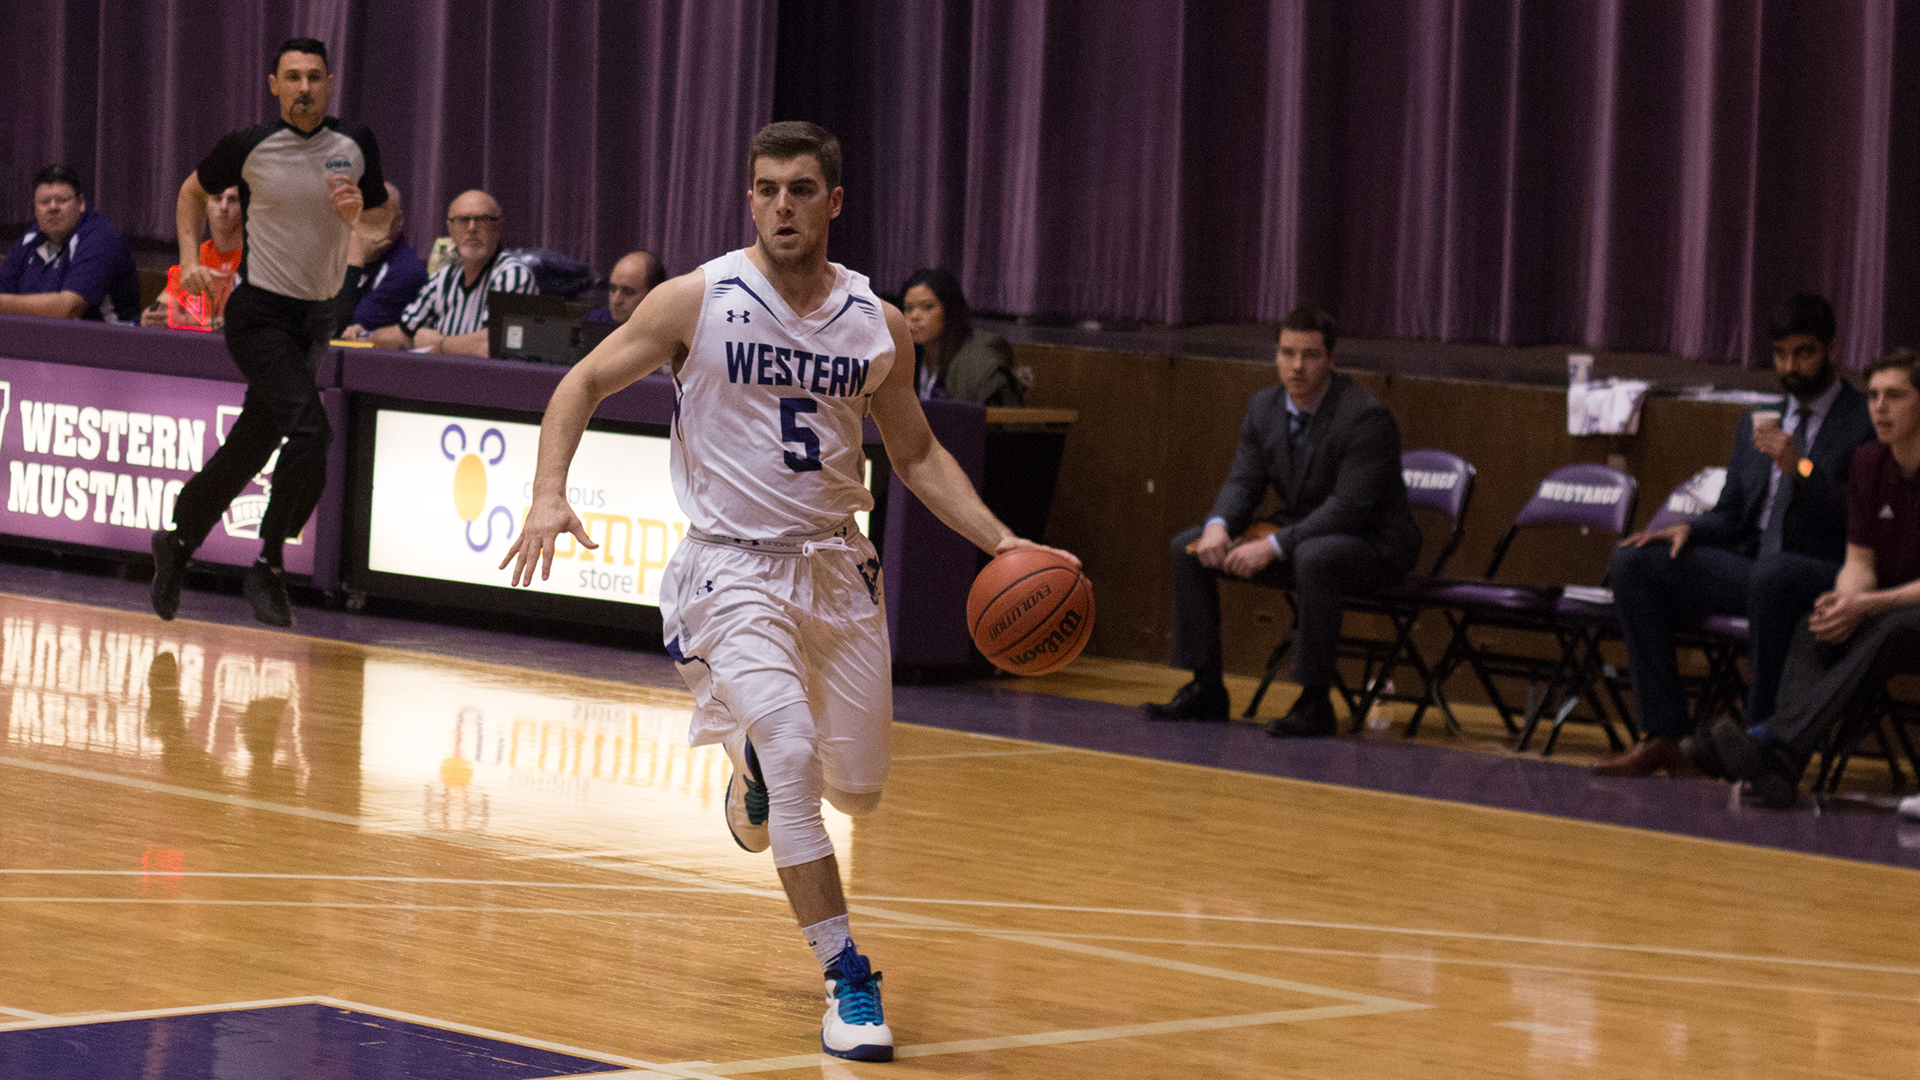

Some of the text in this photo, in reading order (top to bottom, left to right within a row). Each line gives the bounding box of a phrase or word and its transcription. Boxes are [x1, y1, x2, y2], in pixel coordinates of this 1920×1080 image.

[726, 341, 869, 397] WESTERN
[20, 400, 206, 472] WESTERN
[780, 398, 822, 472] 5
[7, 461, 185, 531] MUSTANG
[523, 481, 605, 508] cpus
[1402, 469, 1458, 489] STANGS
[1540, 482, 1623, 505] MUSTANGS
[579, 567, 633, 593] store
[988, 584, 1051, 640] EVOLUTION
[1009, 609, 1082, 666] Wilson
